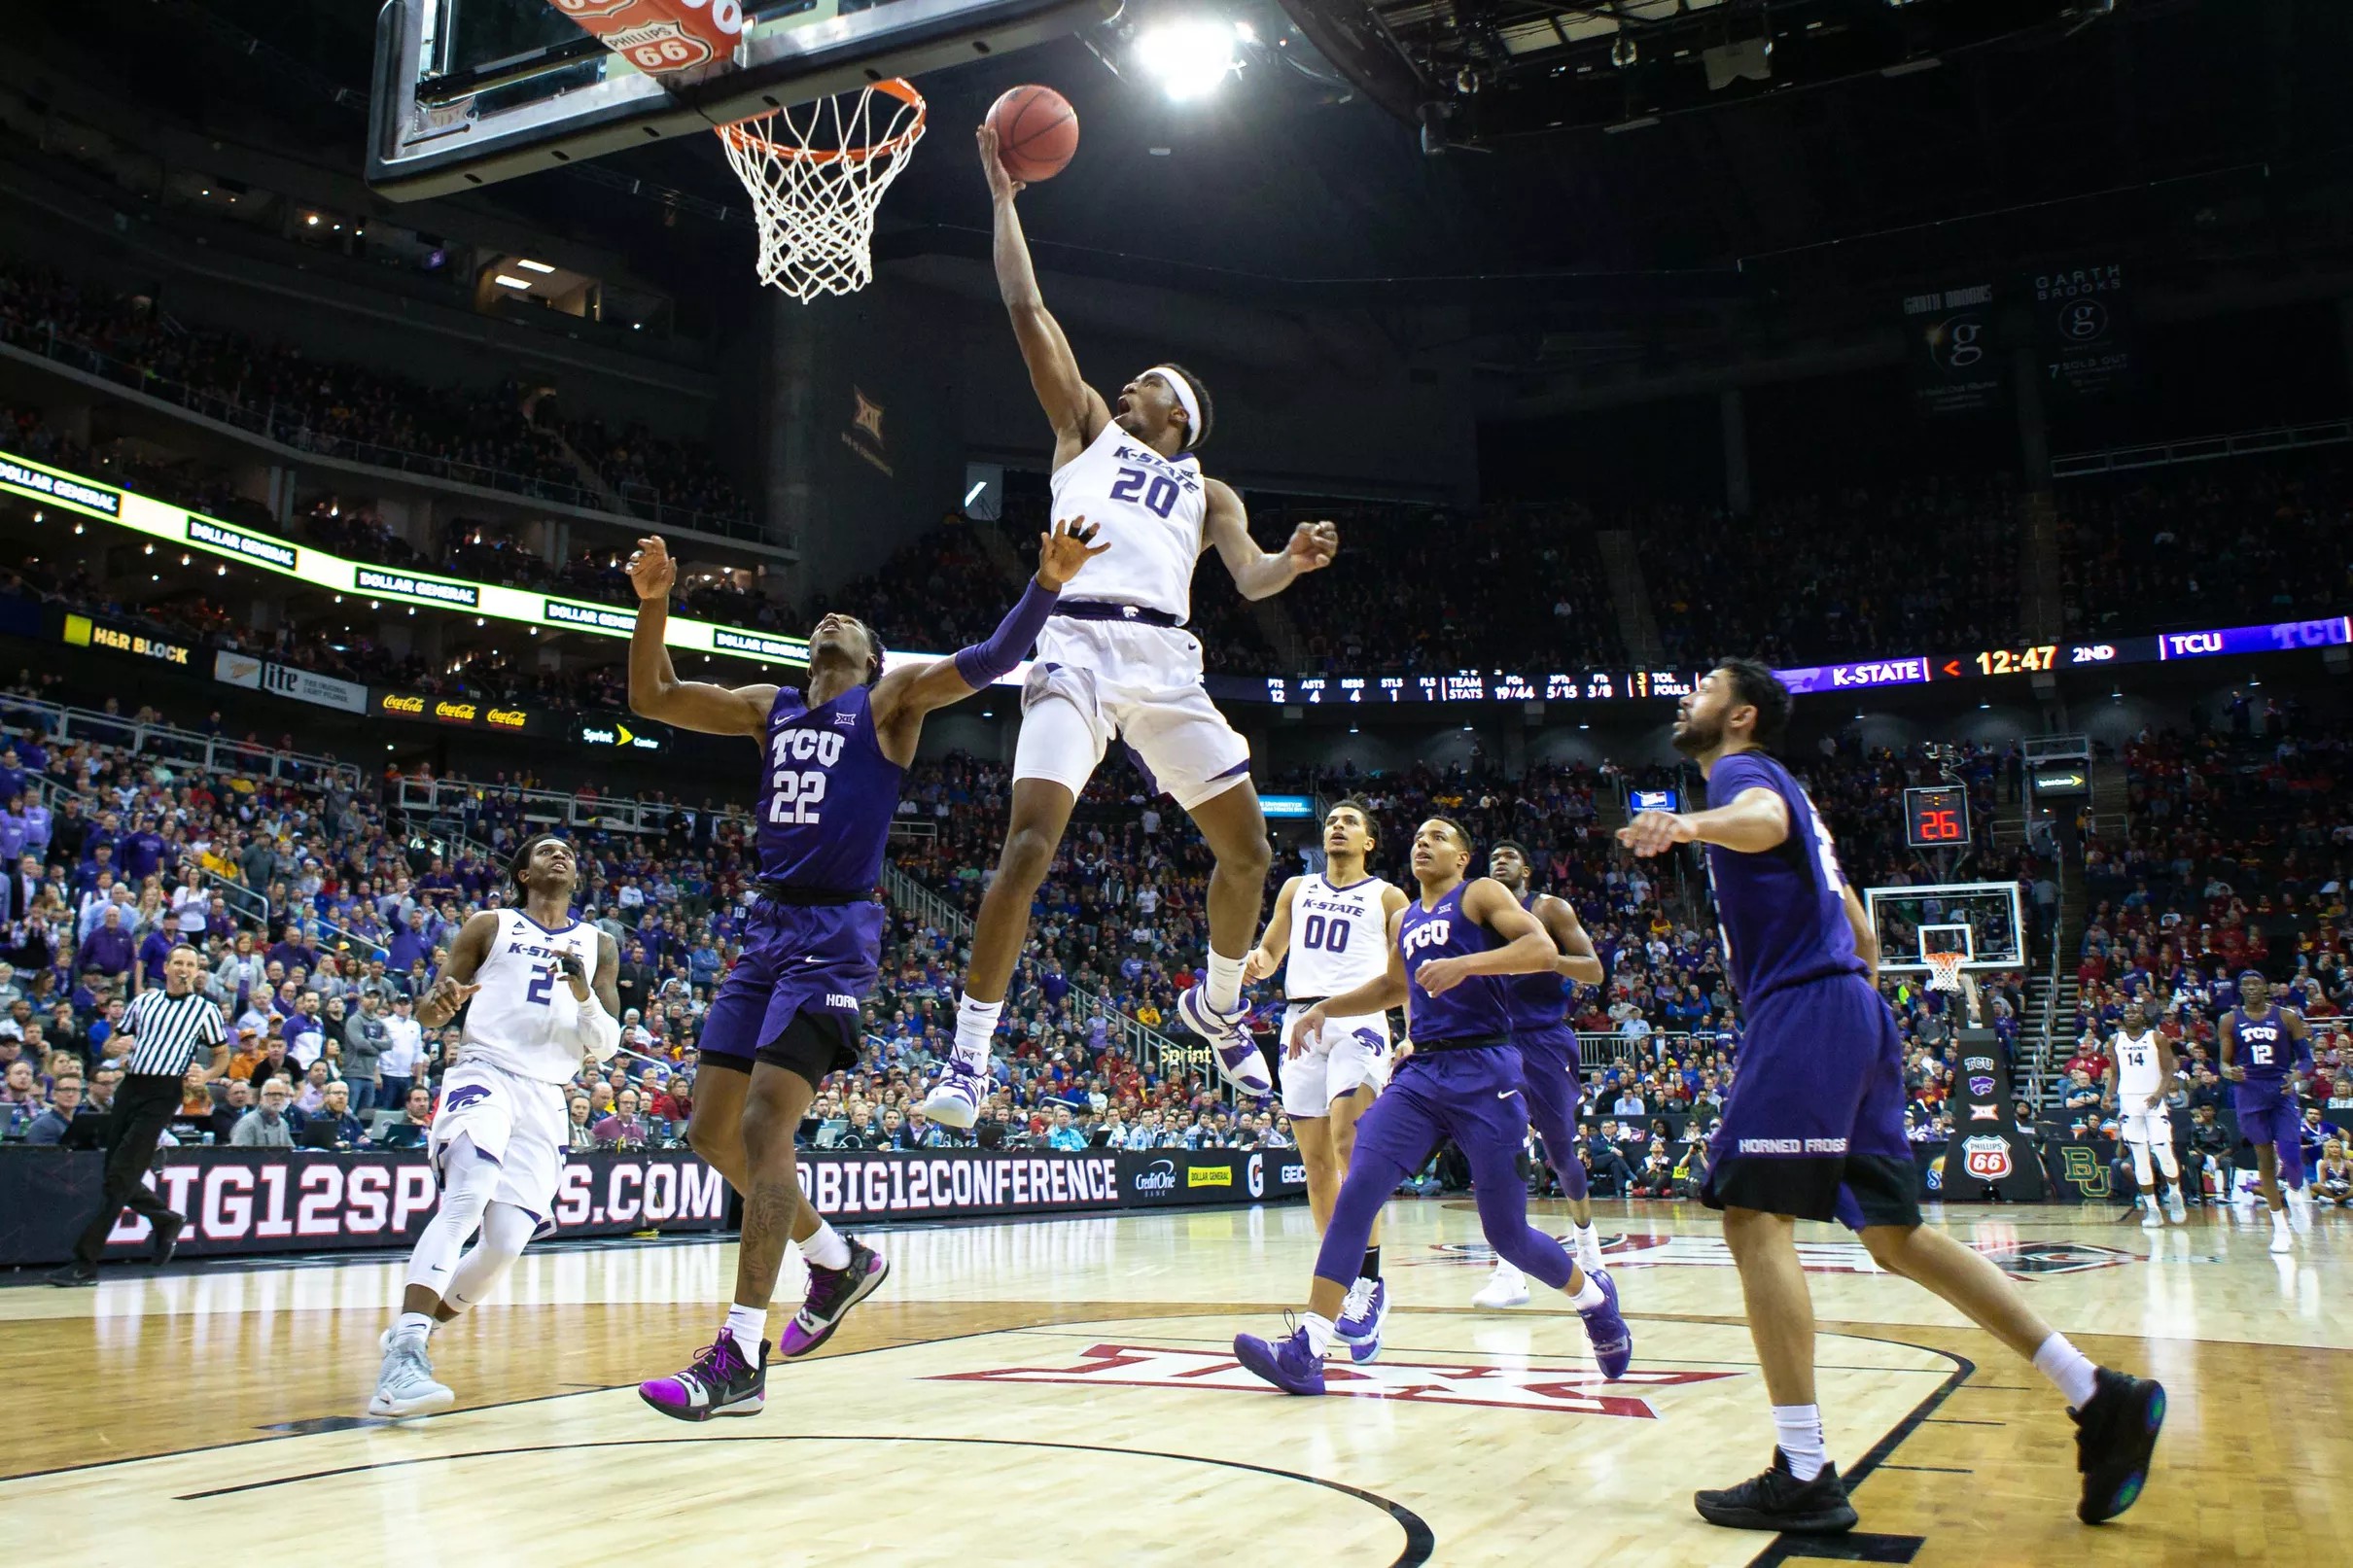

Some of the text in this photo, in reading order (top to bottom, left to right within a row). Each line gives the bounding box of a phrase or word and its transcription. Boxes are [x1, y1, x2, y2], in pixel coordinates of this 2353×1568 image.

[608, 26, 672, 49] PHILLIPS
[634, 40, 688, 66] 66
[2035, 264, 2121, 290] GARTH
[2038, 278, 2121, 301] BROOKS
[2072, 305, 2095, 335] g
[1949, 323, 1983, 366] g
[1113, 445, 1200, 494] K-STATE
[0, 462, 118, 511] DOLLAR GENERAL
[1109, 467, 1179, 519] 20
[191, 522, 295, 566] DOLLAR GENERAL
[360, 572, 474, 604] DOLLAR GENERAL
[548, 604, 637, 631] DOLLAR GENER
[93, 627, 189, 665] H&R BLOCK
[717, 632, 761, 651] DOLLAR
[2169, 617, 2346, 655] TCU TCU
[1976, 645, 2116, 676] 12:47 2ND
[1267, 679, 1284, 689] PTS
[1301, 679, 1325, 689] ASTS
[1341, 679, 1365, 688] REBS
[1381, 678, 1403, 688] STLS
[1448, 678, 1483, 688] TEAM
[1636, 672, 1676, 684] 3 TOL
[1833, 661, 1920, 687] K-STATE
[1271, 688, 1433, 703] 12 4 4 1 1
[1449, 688, 1483, 700] STATS
[1494, 684, 1613, 700] 19/44 5/15 3/8
[1638, 685, 1647, 698] 1
[382, 694, 425, 713] Coca-Cola
[436, 701, 477, 720] Coca-Cola
[486, 708, 528, 727] Coca-Cola
[582, 728, 659, 749] Sprint Center
[772, 728, 845, 768] TCU
[769, 771, 826, 824] 22
[1920, 810, 1959, 839] 26
[1302, 898, 1365, 918] K-STATE
[1304, 915, 1351, 954] 00
[1402, 920, 1452, 960] TCU
[508, 942, 584, 961] K-STE
[526, 964, 555, 1007] 2
[2240, 1027, 2278, 1042] TCU
[1161, 1044, 1212, 1064] Sprint
[1964, 1056, 1993, 1071] TCU
[2127, 1052, 2144, 1066] 14
[2250, 1044, 2274, 1064] 12
[1738, 1137, 1847, 1154] HORNED FROGS
[1970, 1142, 2002, 1151] PHILLIPS
[1973, 1154, 2002, 1171] 66
[2061, 1146, 2112, 1198] BU
[1136, 1171, 1176, 1191] CreditOne
[1191, 1170, 1230, 1182] DOLLAR GENERAL
[1247, 1153, 1263, 1198] G
[1282, 1165, 1307, 1184] GEIC
[105, 1164, 723, 1245] IG12SPS.COM
